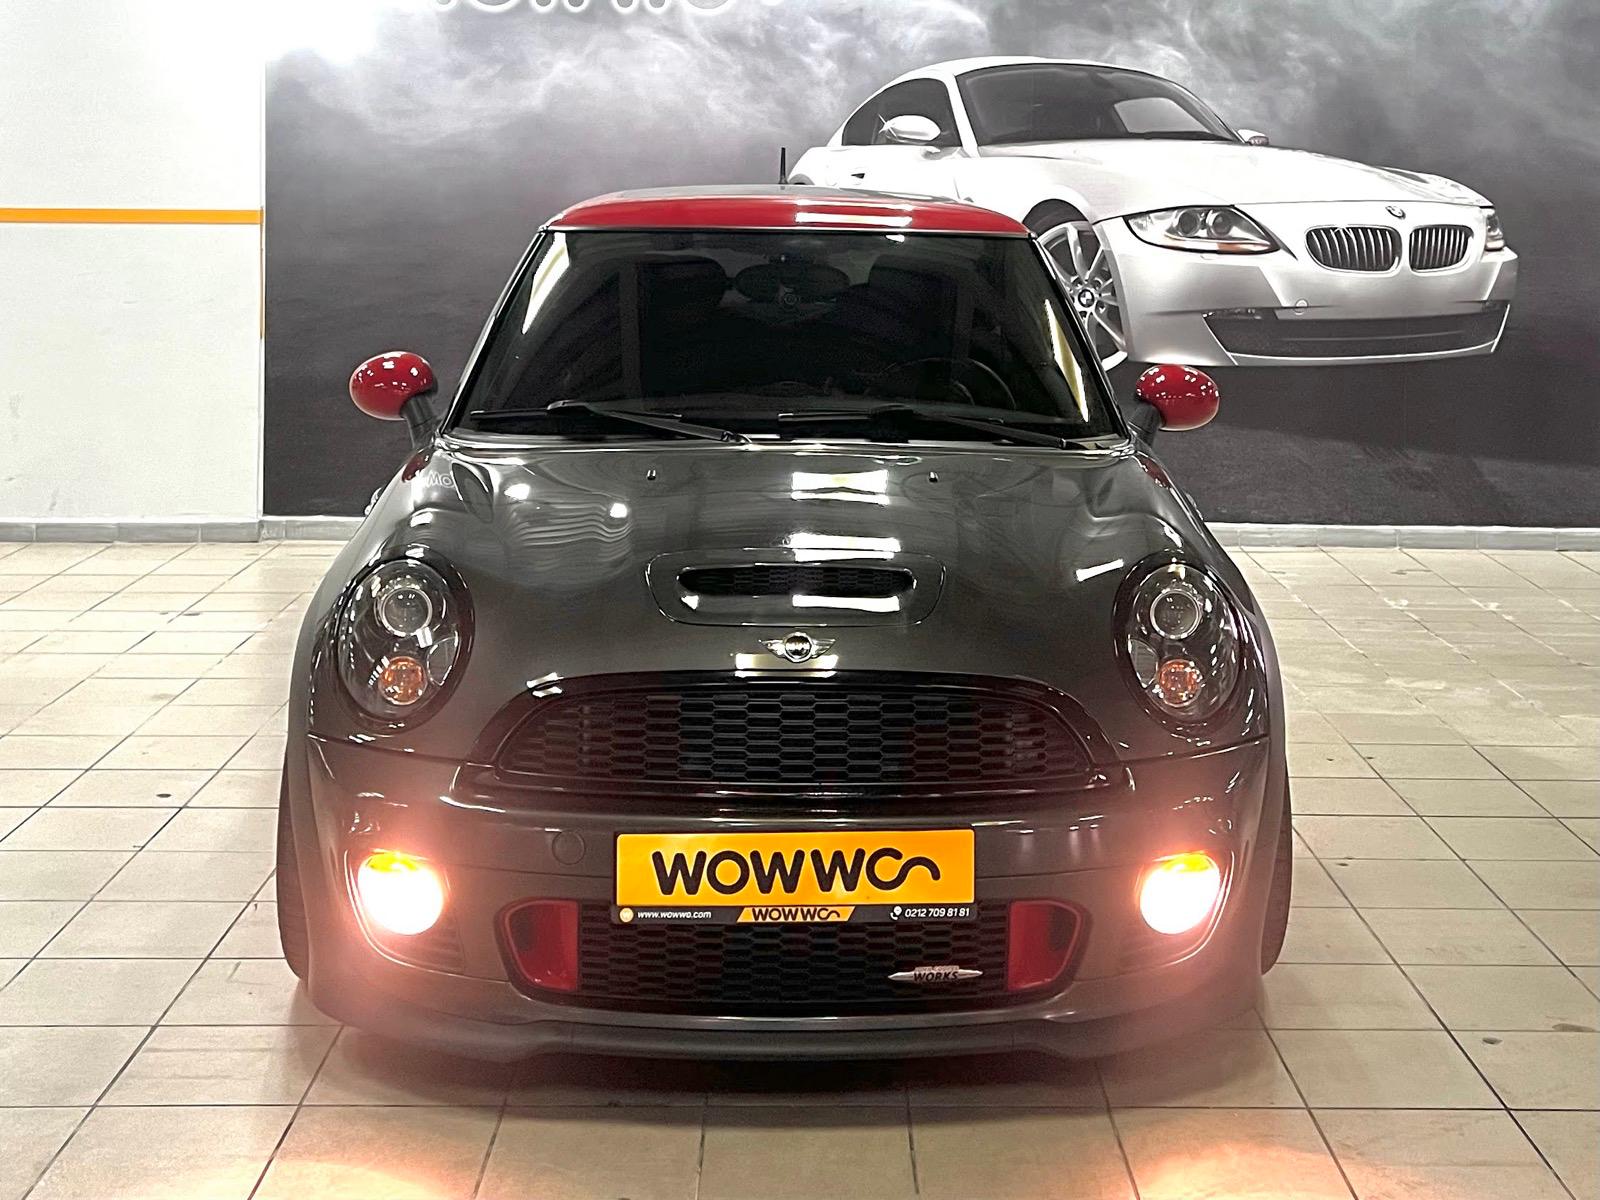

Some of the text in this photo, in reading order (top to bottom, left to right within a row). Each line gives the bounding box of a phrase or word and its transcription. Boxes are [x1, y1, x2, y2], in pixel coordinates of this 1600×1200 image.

[637, 911, 712, 919] www.wowwo.com
[904, 908, 927, 918] 0212
[928, 907, 946, 917] 709
[913, 970, 959, 982] WORKS
